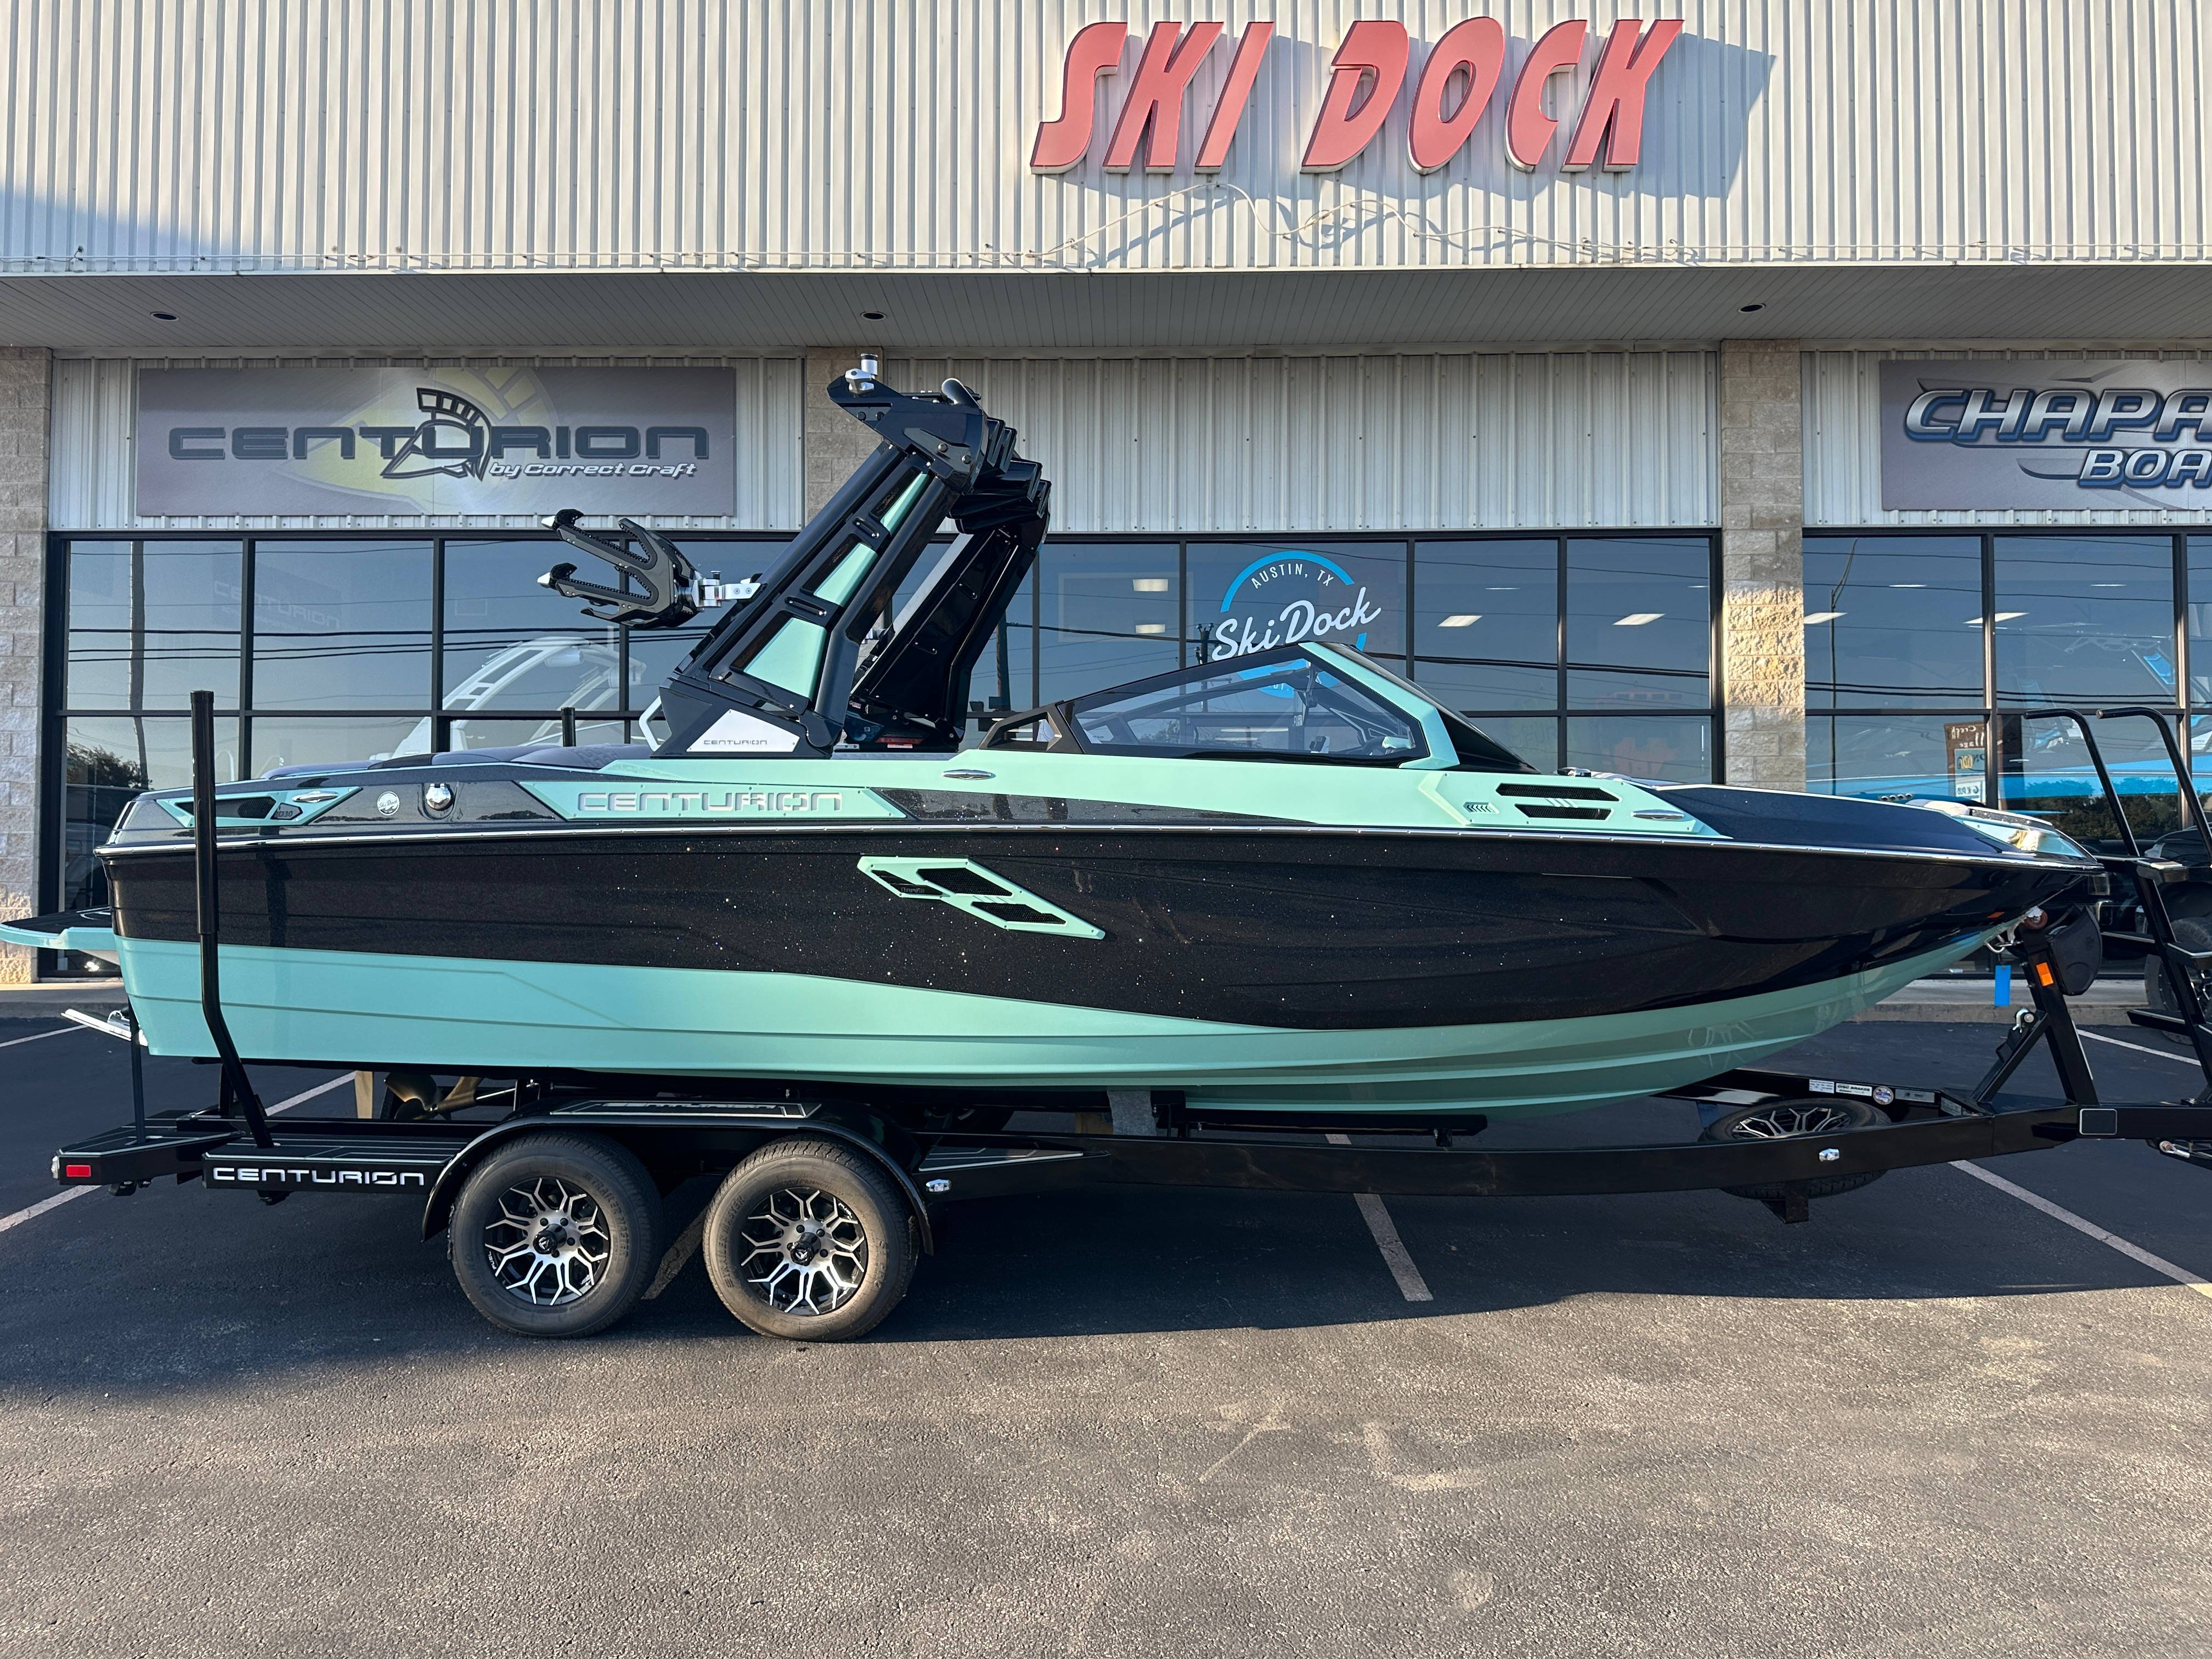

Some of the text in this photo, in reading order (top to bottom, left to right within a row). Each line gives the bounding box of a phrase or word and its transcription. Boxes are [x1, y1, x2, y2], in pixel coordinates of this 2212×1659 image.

[1029, 16, 1684, 176] SKI DOCK
[168, 426, 709, 460] CENTURION
[489, 461, 697, 479] by Correct Craft
[1251, 563, 1334, 589] AUSTIN, TX
[1211, 586, 1382, 662] Ski Dock
[578, 791, 843, 812] CENTURION
[213, 1166, 425, 1186] CENTURION
[488, 1251, 496, 1269] FUEL
